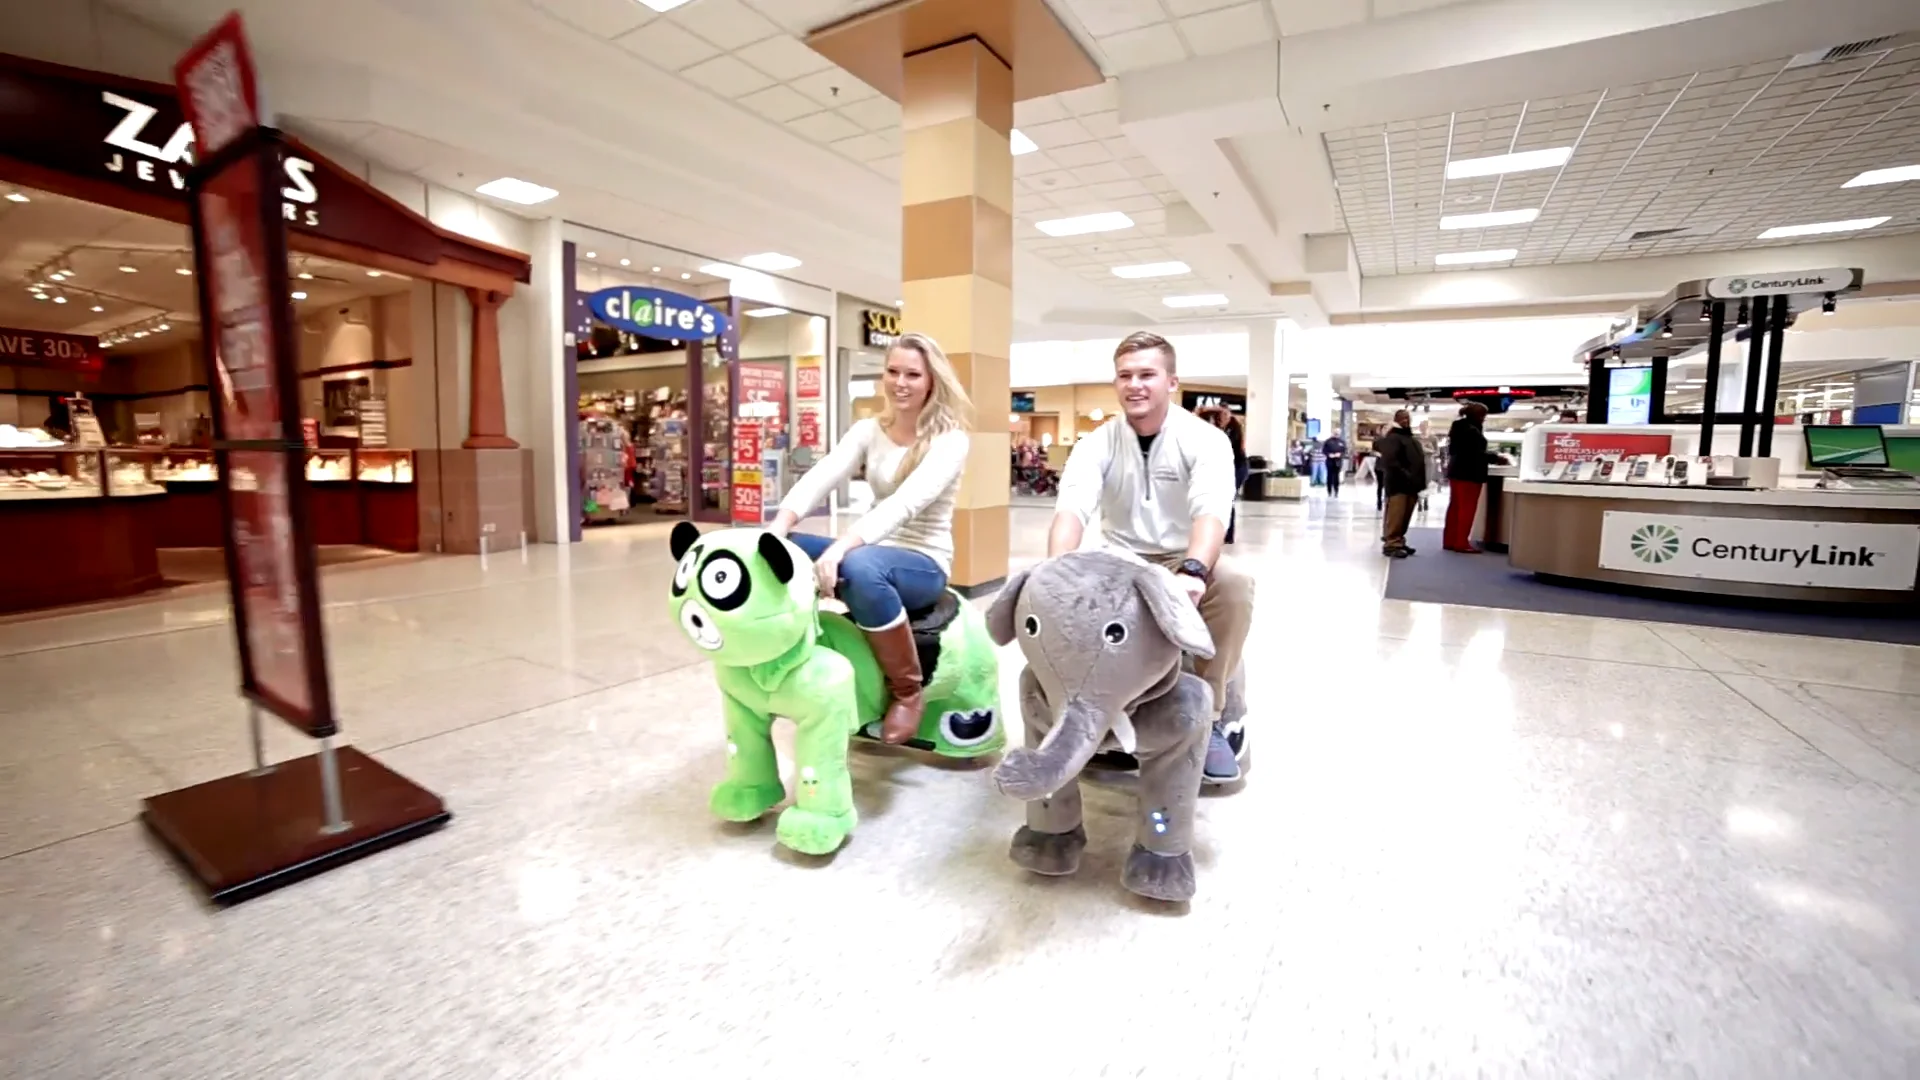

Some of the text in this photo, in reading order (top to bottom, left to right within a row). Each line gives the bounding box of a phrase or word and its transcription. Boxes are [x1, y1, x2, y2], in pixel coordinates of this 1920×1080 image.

[101, 90, 319, 204] ZAS
[1751, 276, 1825, 290] CenturyLink
[605, 290, 715, 334] claire's
[1692, 537, 1875, 568] CenturyLink
